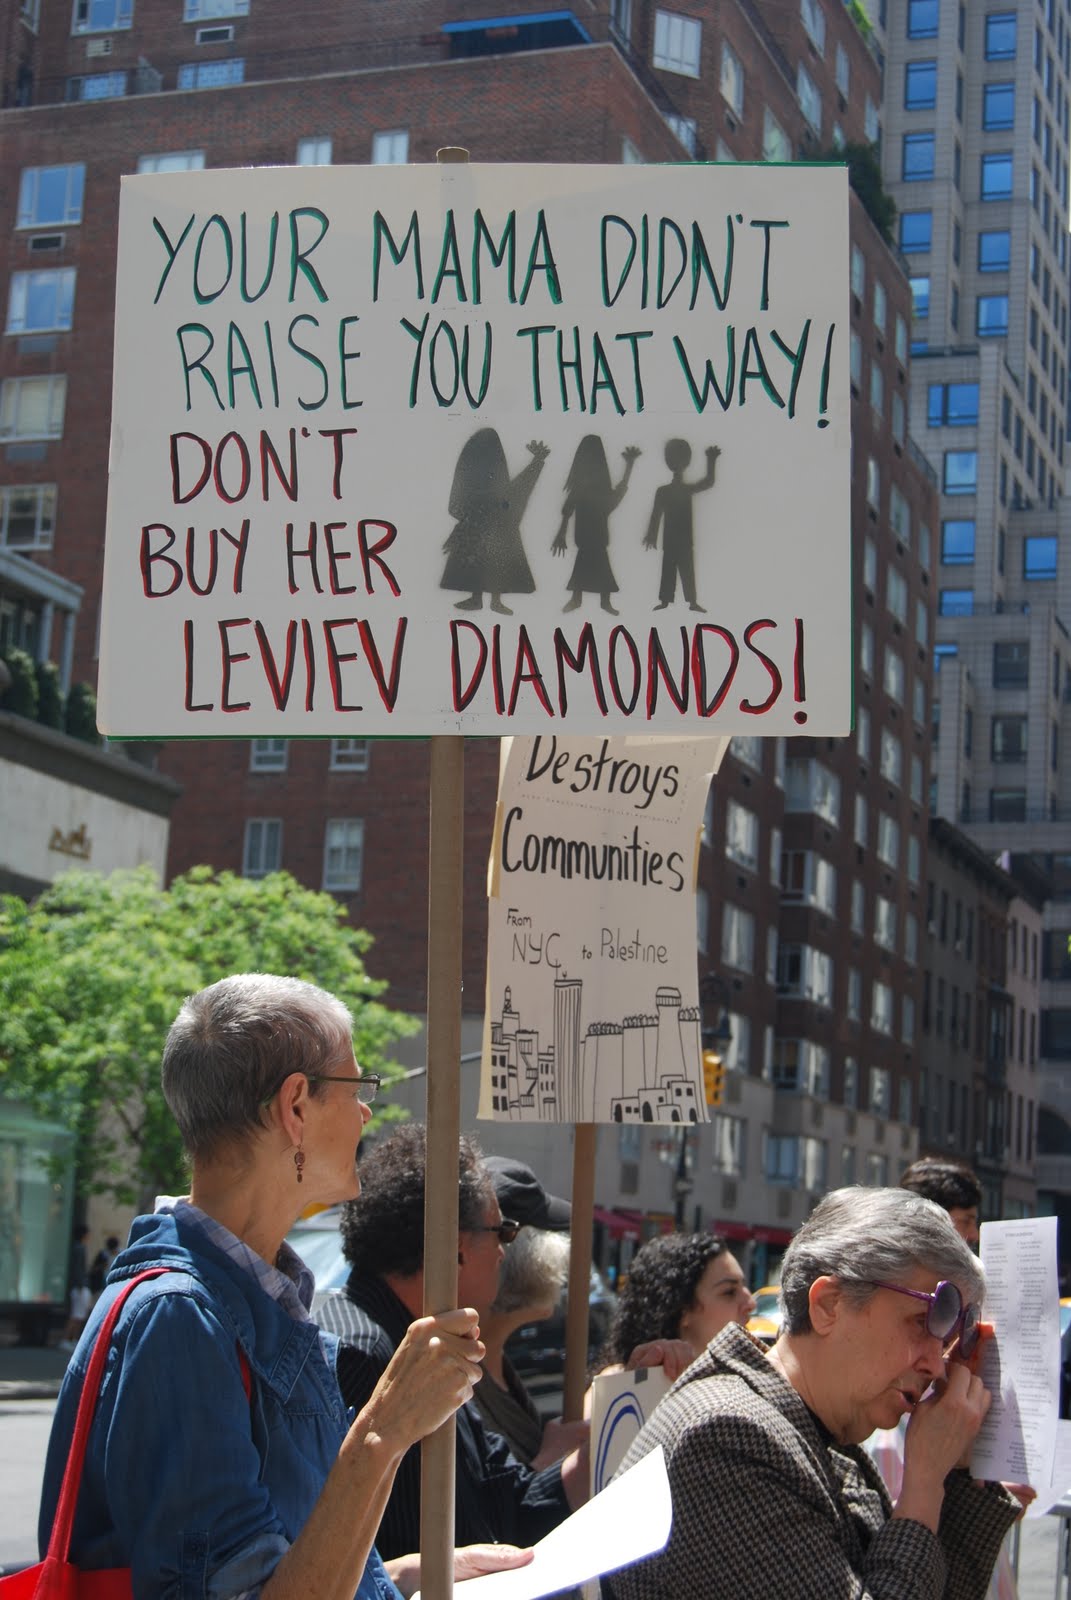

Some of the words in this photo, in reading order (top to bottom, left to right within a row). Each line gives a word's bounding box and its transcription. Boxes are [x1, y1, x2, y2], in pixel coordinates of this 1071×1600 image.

[153, 207, 329, 305] YOUR
[373, 208, 563, 305] MAMA
[601, 214, 790, 311] DIDN'T
[176, 314, 363, 411] RAISE
[400, 312, 492, 409] YOU
[516, 325, 653, 416] THAT
[673, 319, 835, 428] WAY!
[170, 427, 357, 504] DON'T
[140, 519, 250, 598] BUY
[286, 519, 401, 597] HER
[184, 617, 408, 713] LEVIEV
[450, 618, 807, 725] DIAMONDS!
[526, 736, 679, 809] Destroys
[501, 806, 685, 892] Communities
[582, 944, 593, 960] to
[601, 928, 669, 964] Palestine
